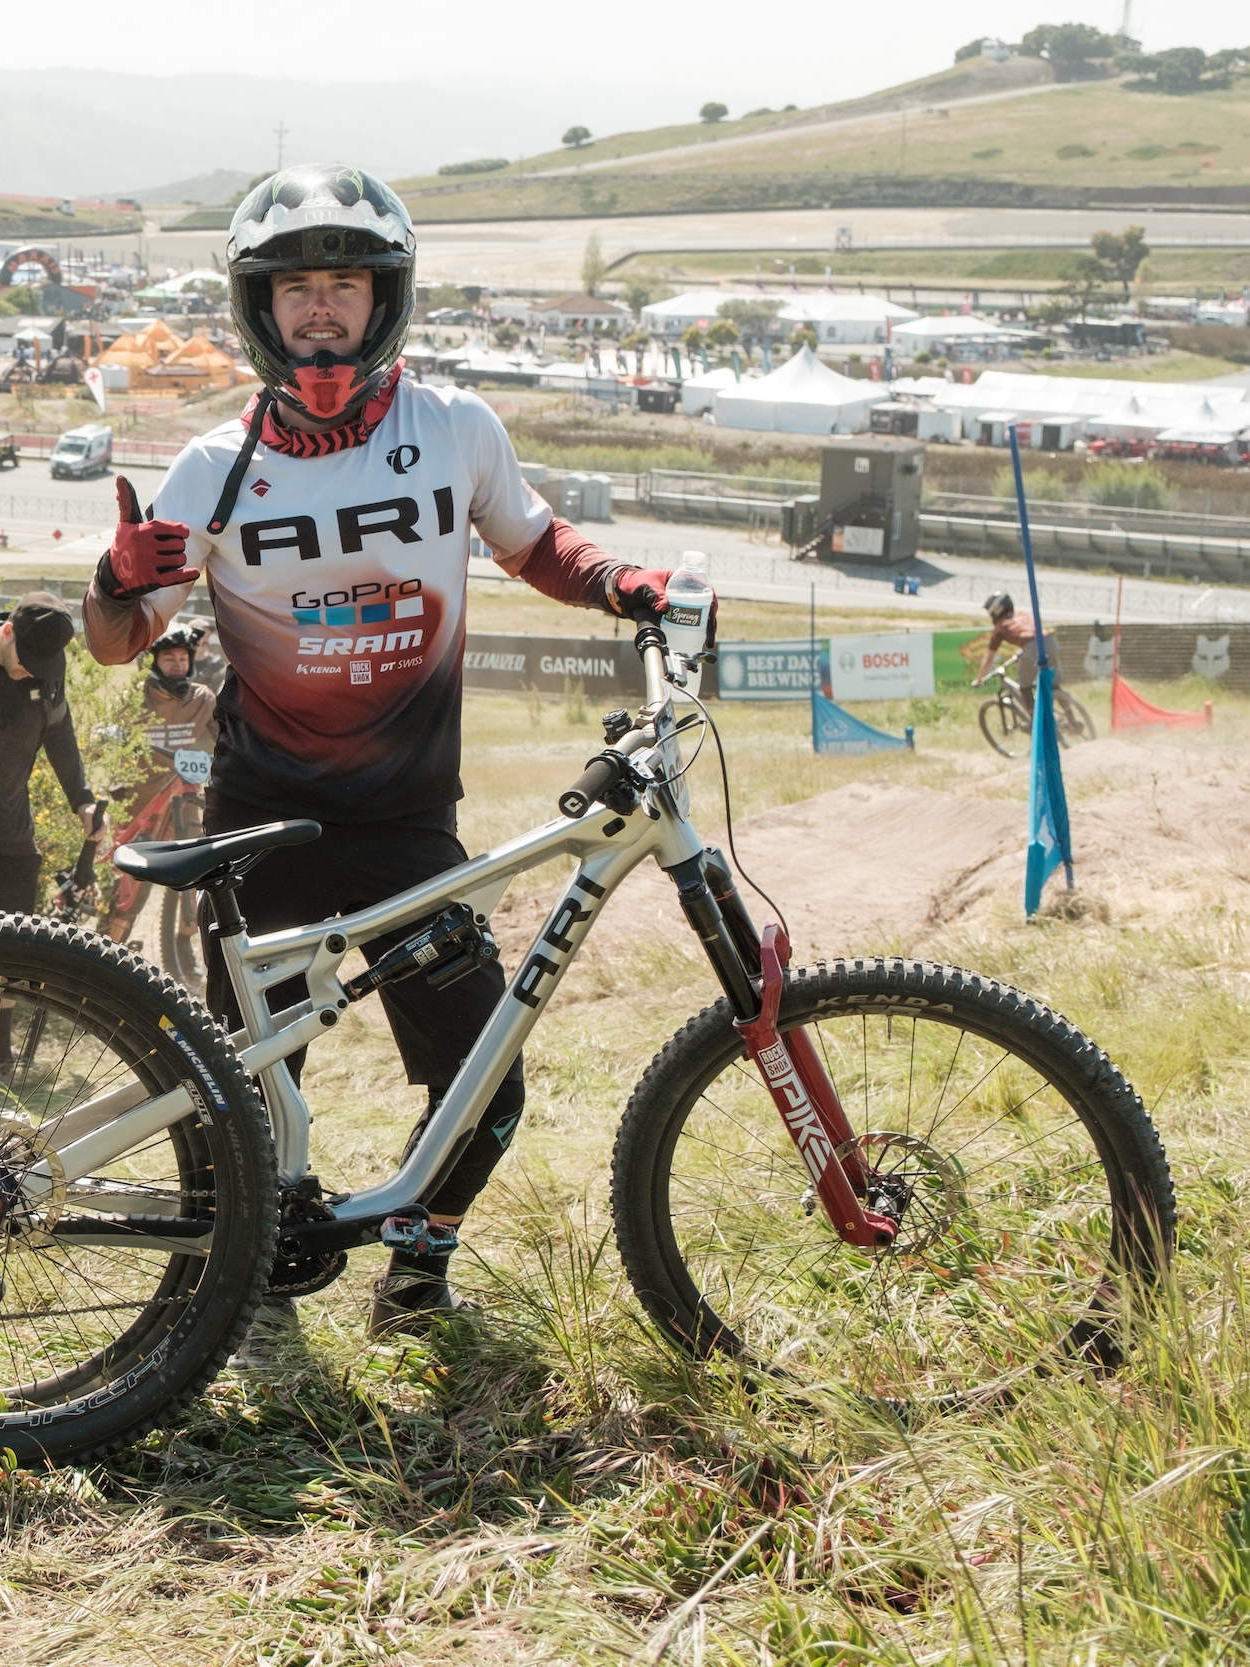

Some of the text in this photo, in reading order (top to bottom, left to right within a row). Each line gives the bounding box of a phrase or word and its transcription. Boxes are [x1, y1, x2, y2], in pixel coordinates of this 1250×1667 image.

[240, 486, 454, 566] ARI
[292, 579, 422, 608] GoPro
[672, 608, 700, 625] Spring
[297, 629, 424, 656] SRAM
[310, 666, 341, 674] KENDA
[352, 663, 369, 672] ROCK
[380, 656, 423, 673] DT SWISS
[463, 652, 526, 671] PECIALIZED
[540, 656, 614, 677] GARMIN
[747, 655, 820, 670] BEST DAY
[862, 652, 909, 669] BOSCH
[353, 673, 370, 682] SHOX
[747, 672, 821, 687] BREWING
[180, 761, 208, 774] 205
[513, 874, 606, 1009] ARI
[816, 994, 954, 1013] KENDA
[761, 1045, 784, 1064] ROCK
[177, 1040, 226, 1105] MICHELIN
[768, 1058, 789, 1076] SHOX
[770, 1070, 831, 1183] PIKE
[225, 1118, 244, 1166] WILD
